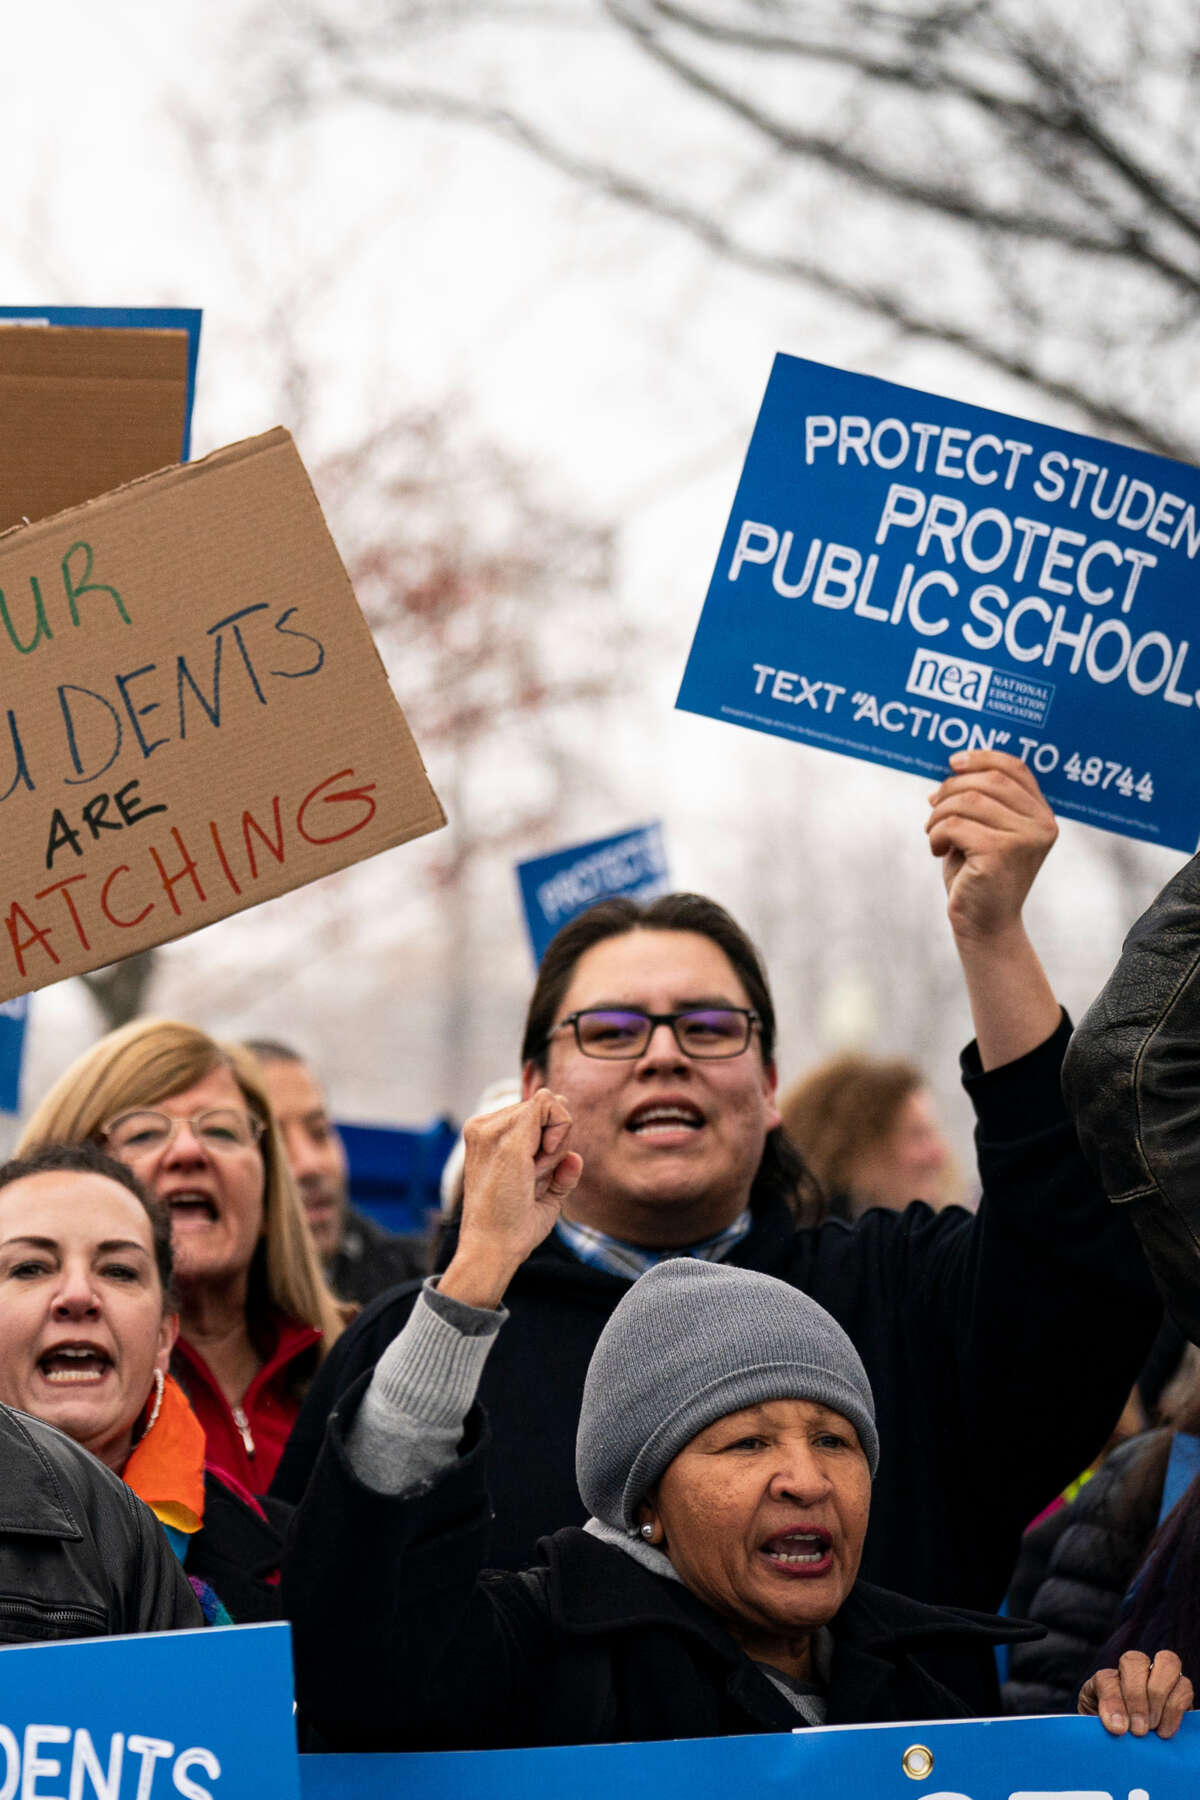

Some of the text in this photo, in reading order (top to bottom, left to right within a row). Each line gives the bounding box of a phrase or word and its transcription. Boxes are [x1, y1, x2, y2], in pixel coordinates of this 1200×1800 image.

[805, 415, 1200, 559] PROTECT STUDEN
[875, 483, 1158, 613] PROTECT
[728, 520, 1200, 707] PUBLIC SCHOOL
[753, 663, 845, 712] TEXT
[851, 691, 1011, 751] "ACTION"
[1018, 736, 1059, 773] TO
[1063, 752, 1155, 803] 48744
[913, 659, 982, 703] nea
[988, 686, 1046, 711] EDUCATION
[991, 674, 1049, 700] NATIONAL
[45, 780, 167, 869] ARE
